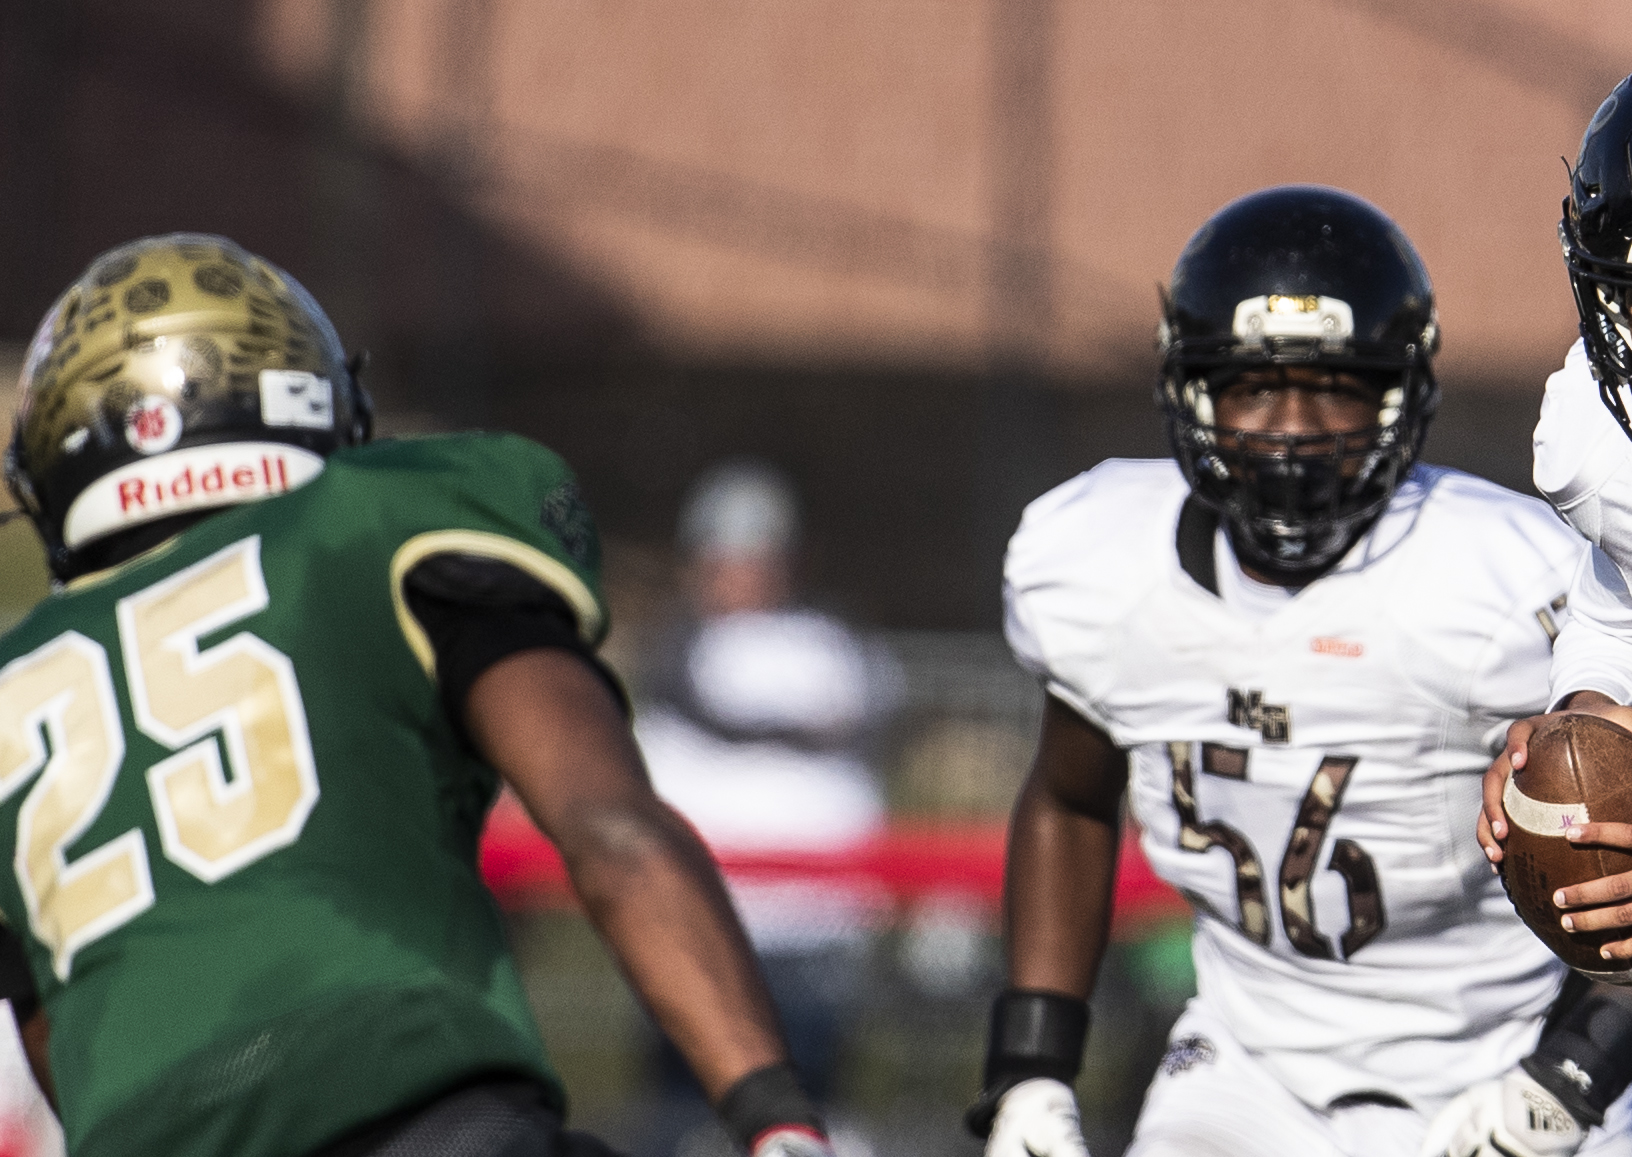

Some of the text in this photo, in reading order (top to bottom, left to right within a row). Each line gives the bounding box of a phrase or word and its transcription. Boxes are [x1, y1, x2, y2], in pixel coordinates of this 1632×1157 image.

[116, 454, 289, 513] Riddell
[0, 534, 321, 983] 25
[1167, 741, 1387, 961] 56
